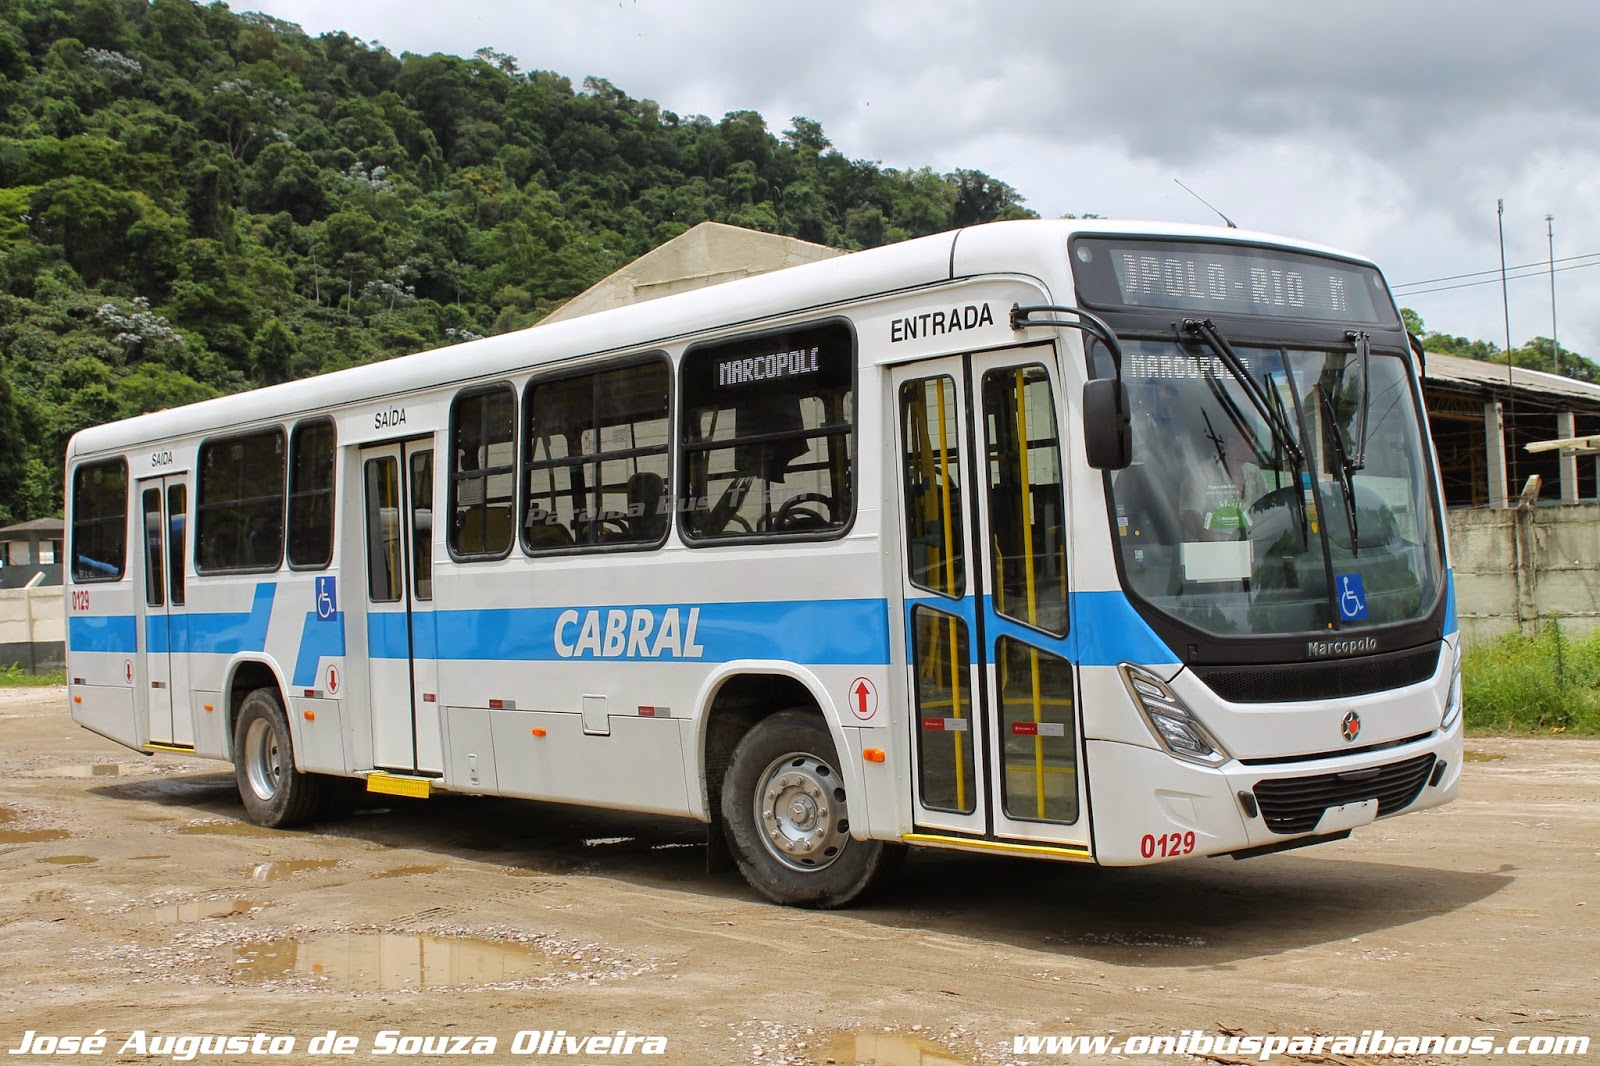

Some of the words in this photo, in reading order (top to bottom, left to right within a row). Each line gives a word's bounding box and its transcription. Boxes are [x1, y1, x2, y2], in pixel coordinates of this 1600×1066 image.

[890, 302, 994, 343] ENTRADA
[374, 404, 407, 430] SAÍDA
[151, 447, 173, 467] SAÍDA
[72, 590, 90, 611] 0129
[553, 607, 705, 658] CABRAL
[1308, 637, 1378, 657] Marcopolo
[1140, 830, 1196, 859] 0129
